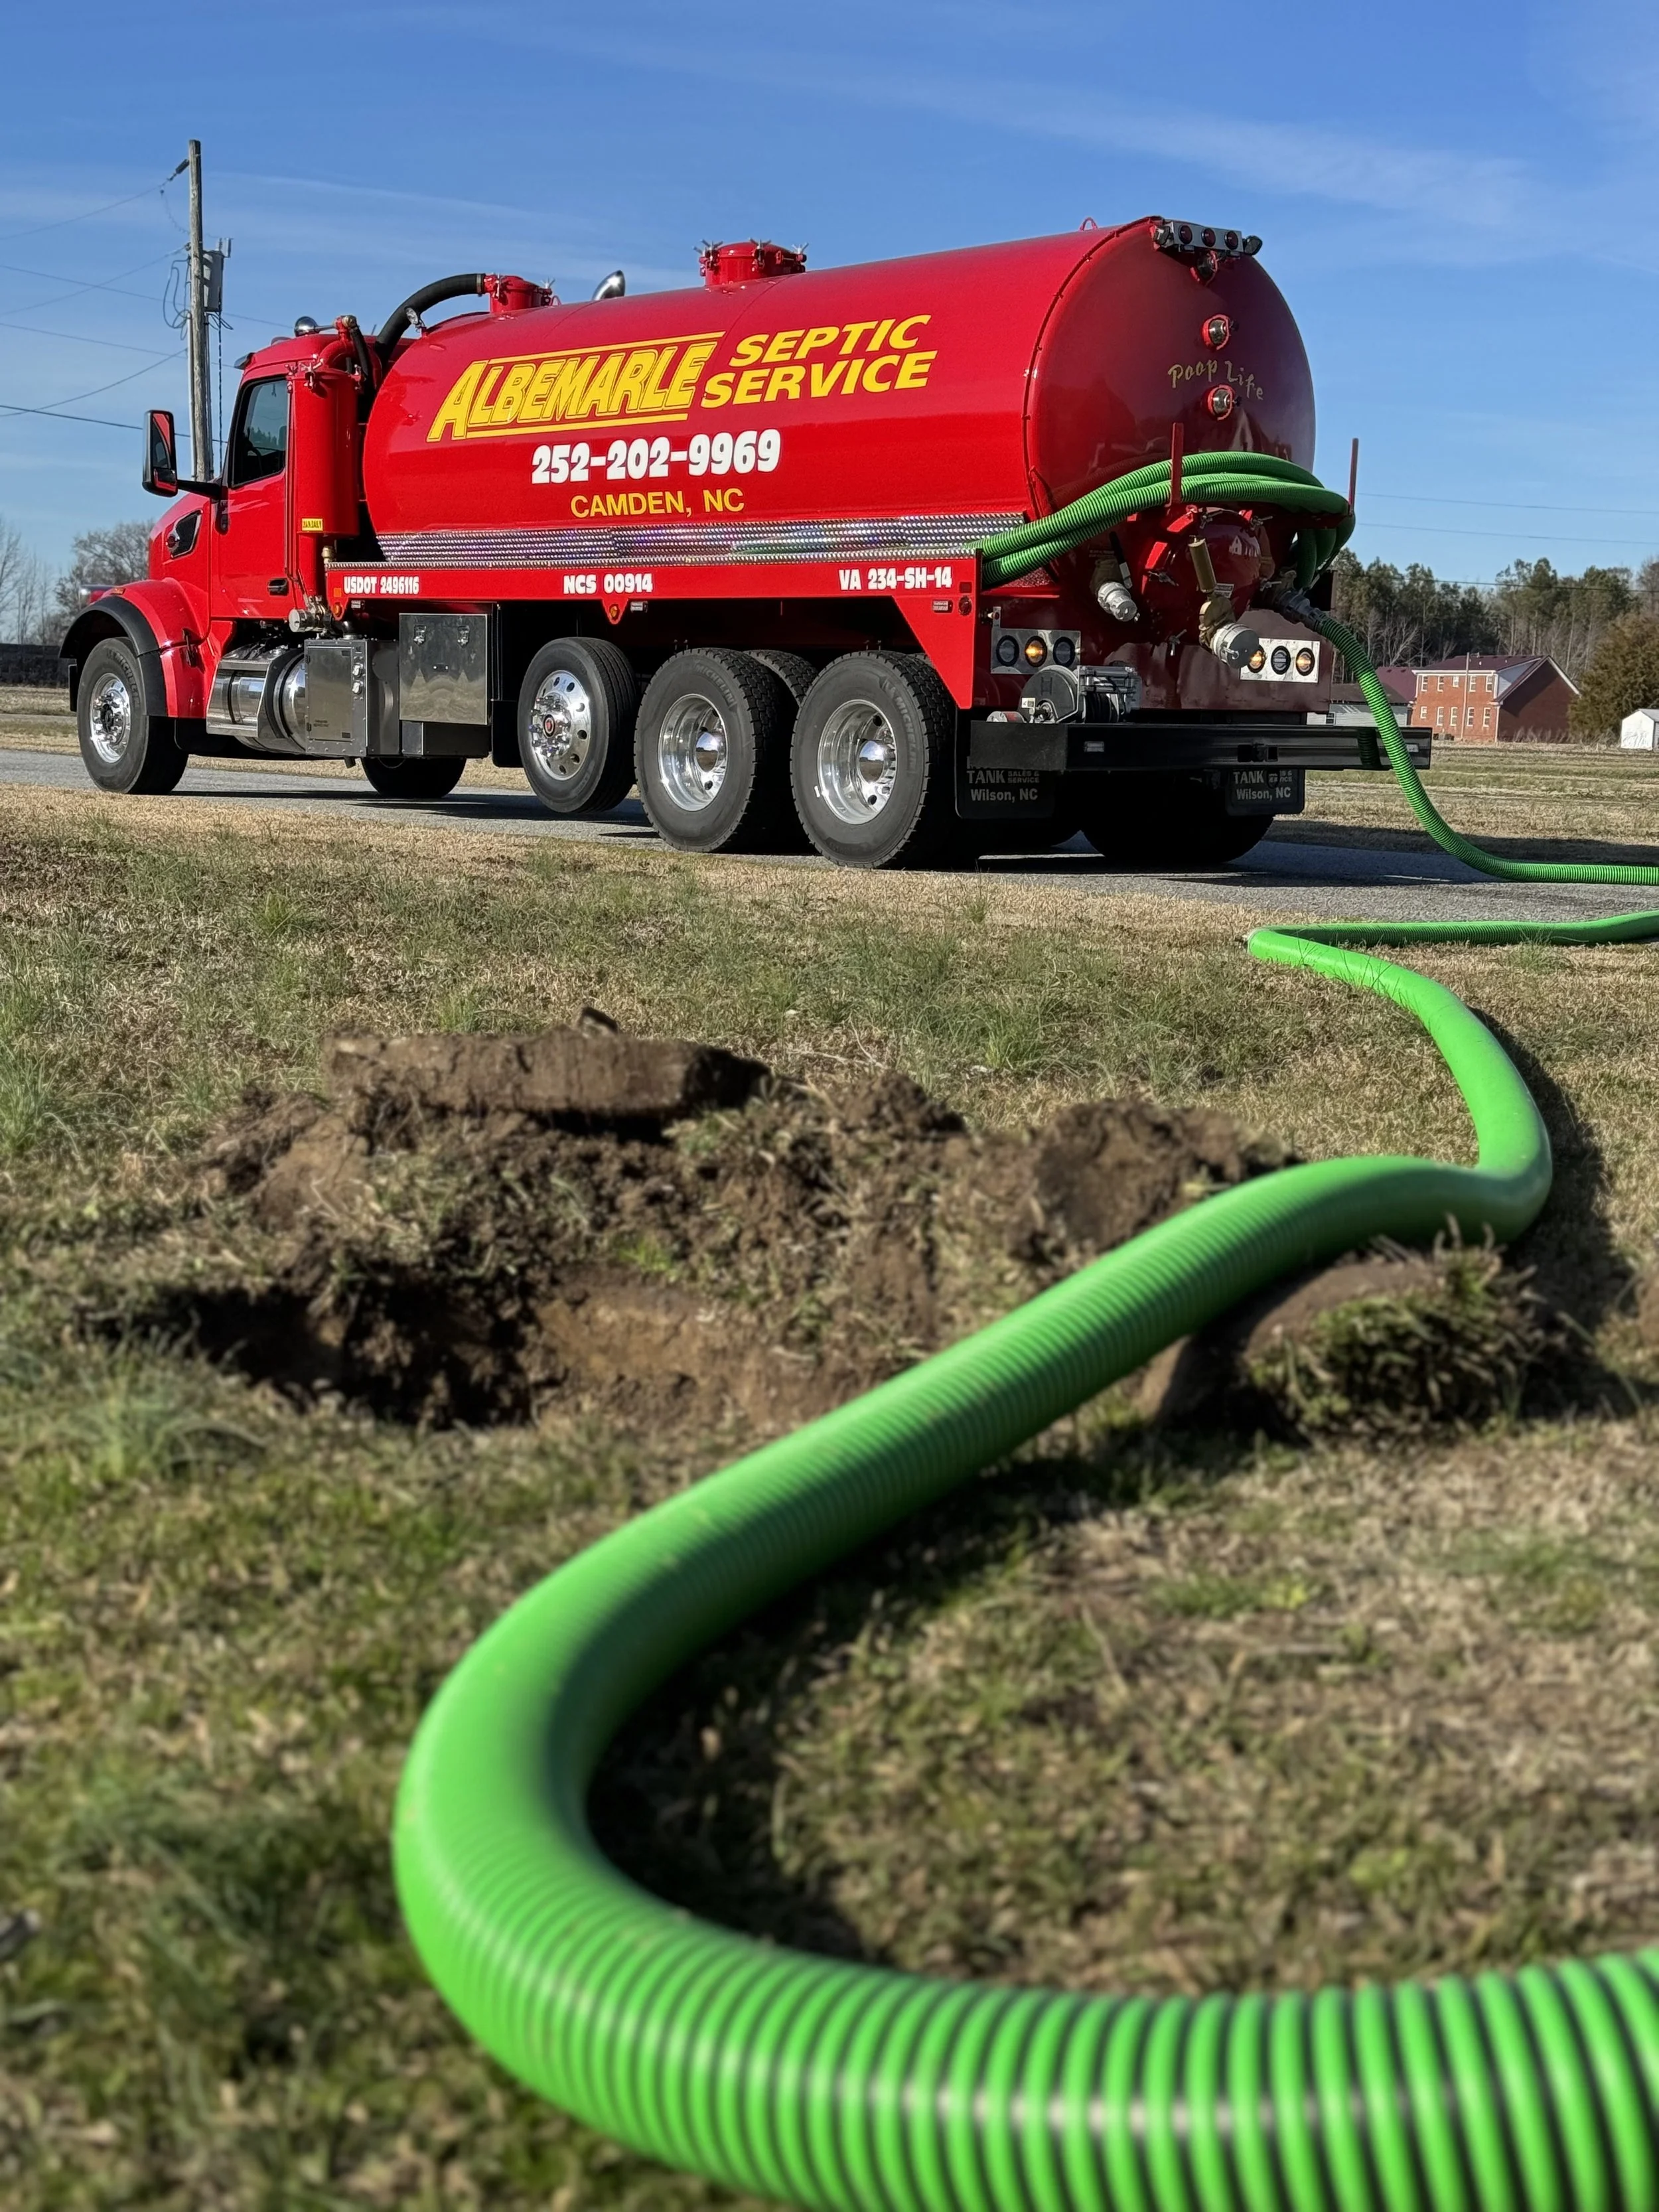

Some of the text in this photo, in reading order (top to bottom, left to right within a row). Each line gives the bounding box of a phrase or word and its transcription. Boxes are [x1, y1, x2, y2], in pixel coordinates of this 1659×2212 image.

[729, 315, 932, 367] SEPTIC
[700, 350, 938, 408] SERVICE
[1167, 359, 1263, 400] Poop Life
[426, 341, 718, 442] ALBEMARLE
[532, 429, 781, 484] 252-202-9969
[571, 488, 745, 518] CAMDEN, NC
[344, 576, 419, 595] USDOT 2496116
[563, 573, 653, 594] NCS 00914
[838, 566, 952, 590] VA 234-SH-14
[966, 770, 1005, 784] TANK
[1233, 771, 1264, 784] TANK
[970, 788, 1038, 803] Wilson, NC
[1236, 786, 1291, 801] Wilson, NC
